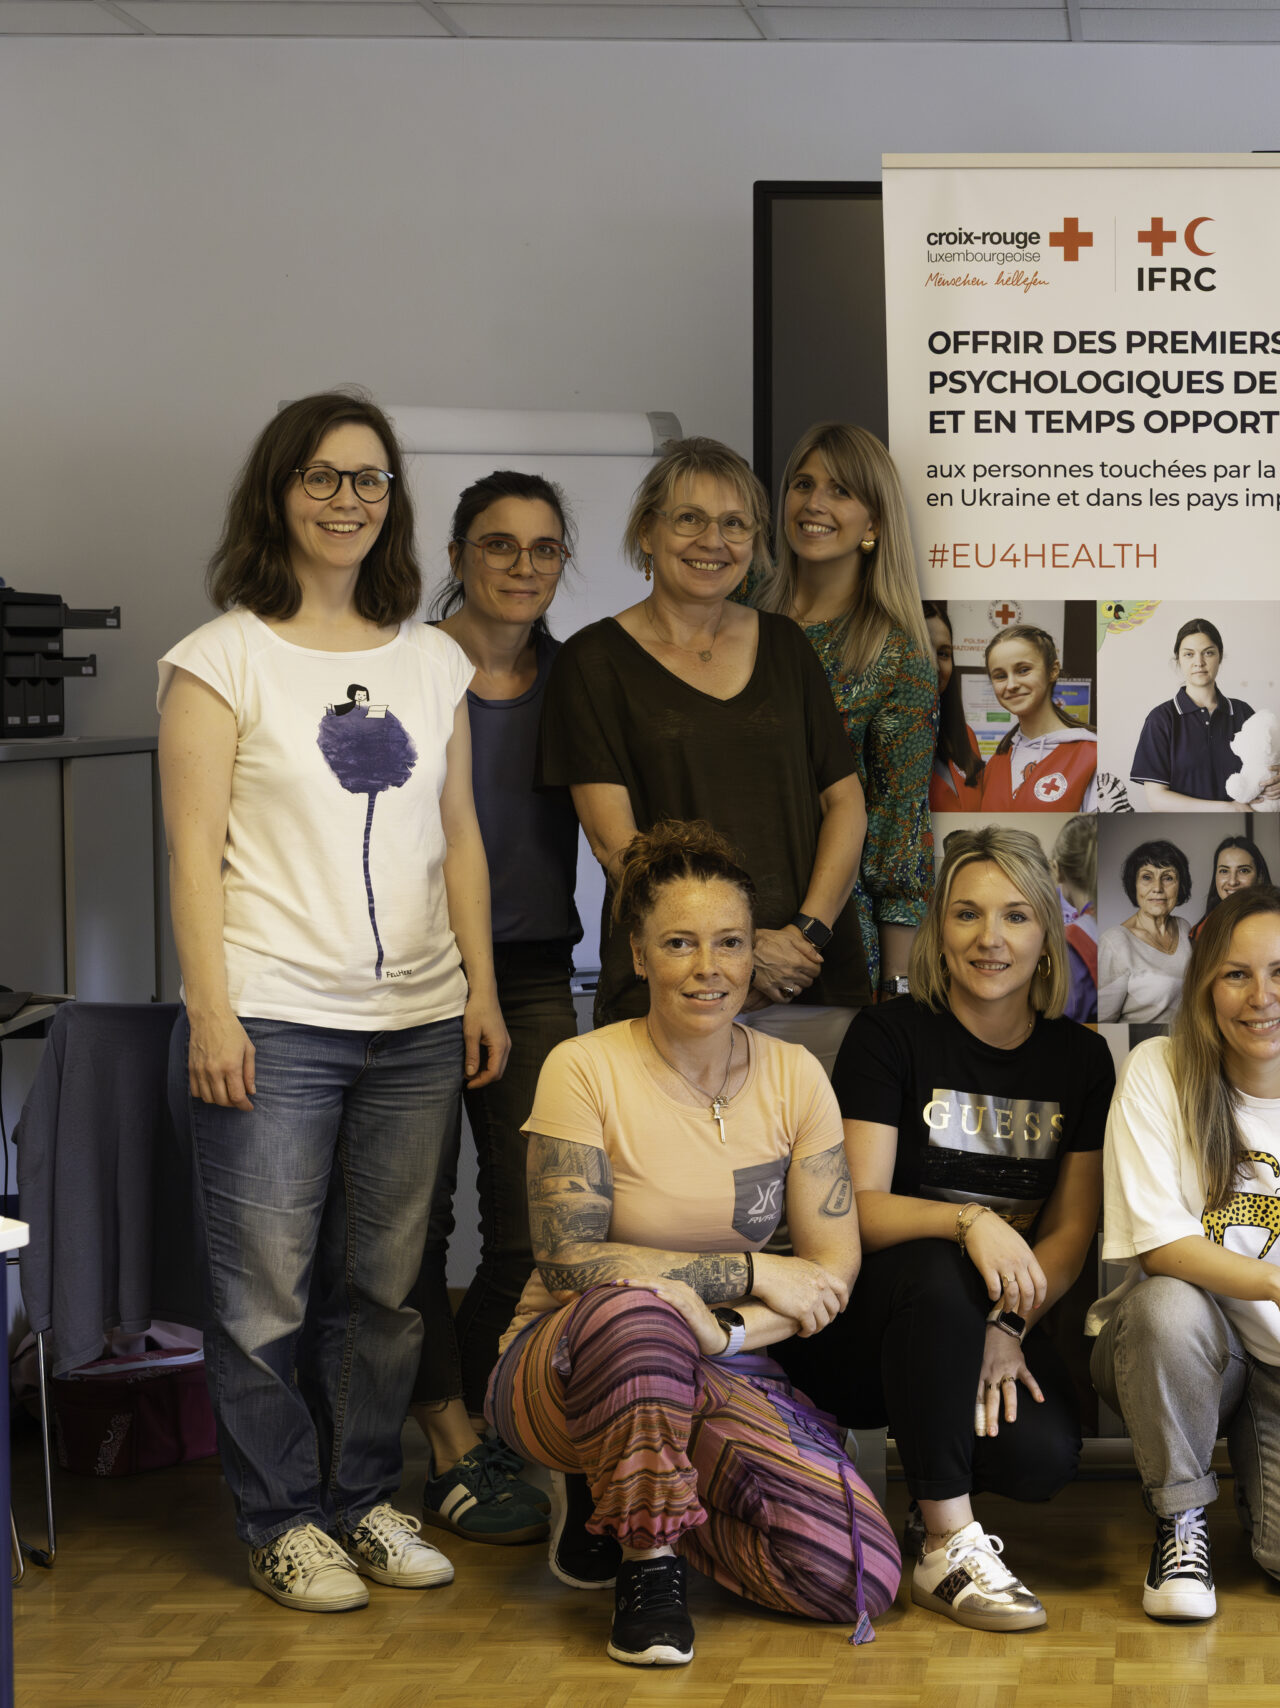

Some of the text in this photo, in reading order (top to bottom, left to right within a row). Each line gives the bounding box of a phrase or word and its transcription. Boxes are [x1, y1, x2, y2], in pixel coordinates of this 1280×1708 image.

[926, 227, 1041, 249] croix-rouge
[927, 249, 1041, 265] luxembourgeoise
[1137, 266, 1217, 293] IFRC
[927, 330, 1044, 356] OFFRIR
[1053, 330, 1117, 355] DES
[928, 370, 1225, 400] PSYCHOLOGIQUES
[1233, 370, 1278, 395] DE
[928, 410, 966, 434] ET
[973, 410, 1017, 434] EN
[1024, 409, 1136, 434] TEMPS
[926, 463, 967, 479] aux
[972, 463, 1094, 483] personnes
[1098, 458, 1207, 479] touchées
[1213, 463, 1252, 483] par
[1257, 459, 1276, 479] la
[926, 492, 954, 507] en
[960, 487, 1051, 507] Ukraine
[1056, 490, 1081, 507] et
[1085, 487, 1143, 507] dans
[1149, 487, 1180, 507] les
[1186, 492, 1239, 512] pays
[928, 543, 1158, 570] #EU4HEALTH
[922, 1100, 1065, 1142] GUESS
